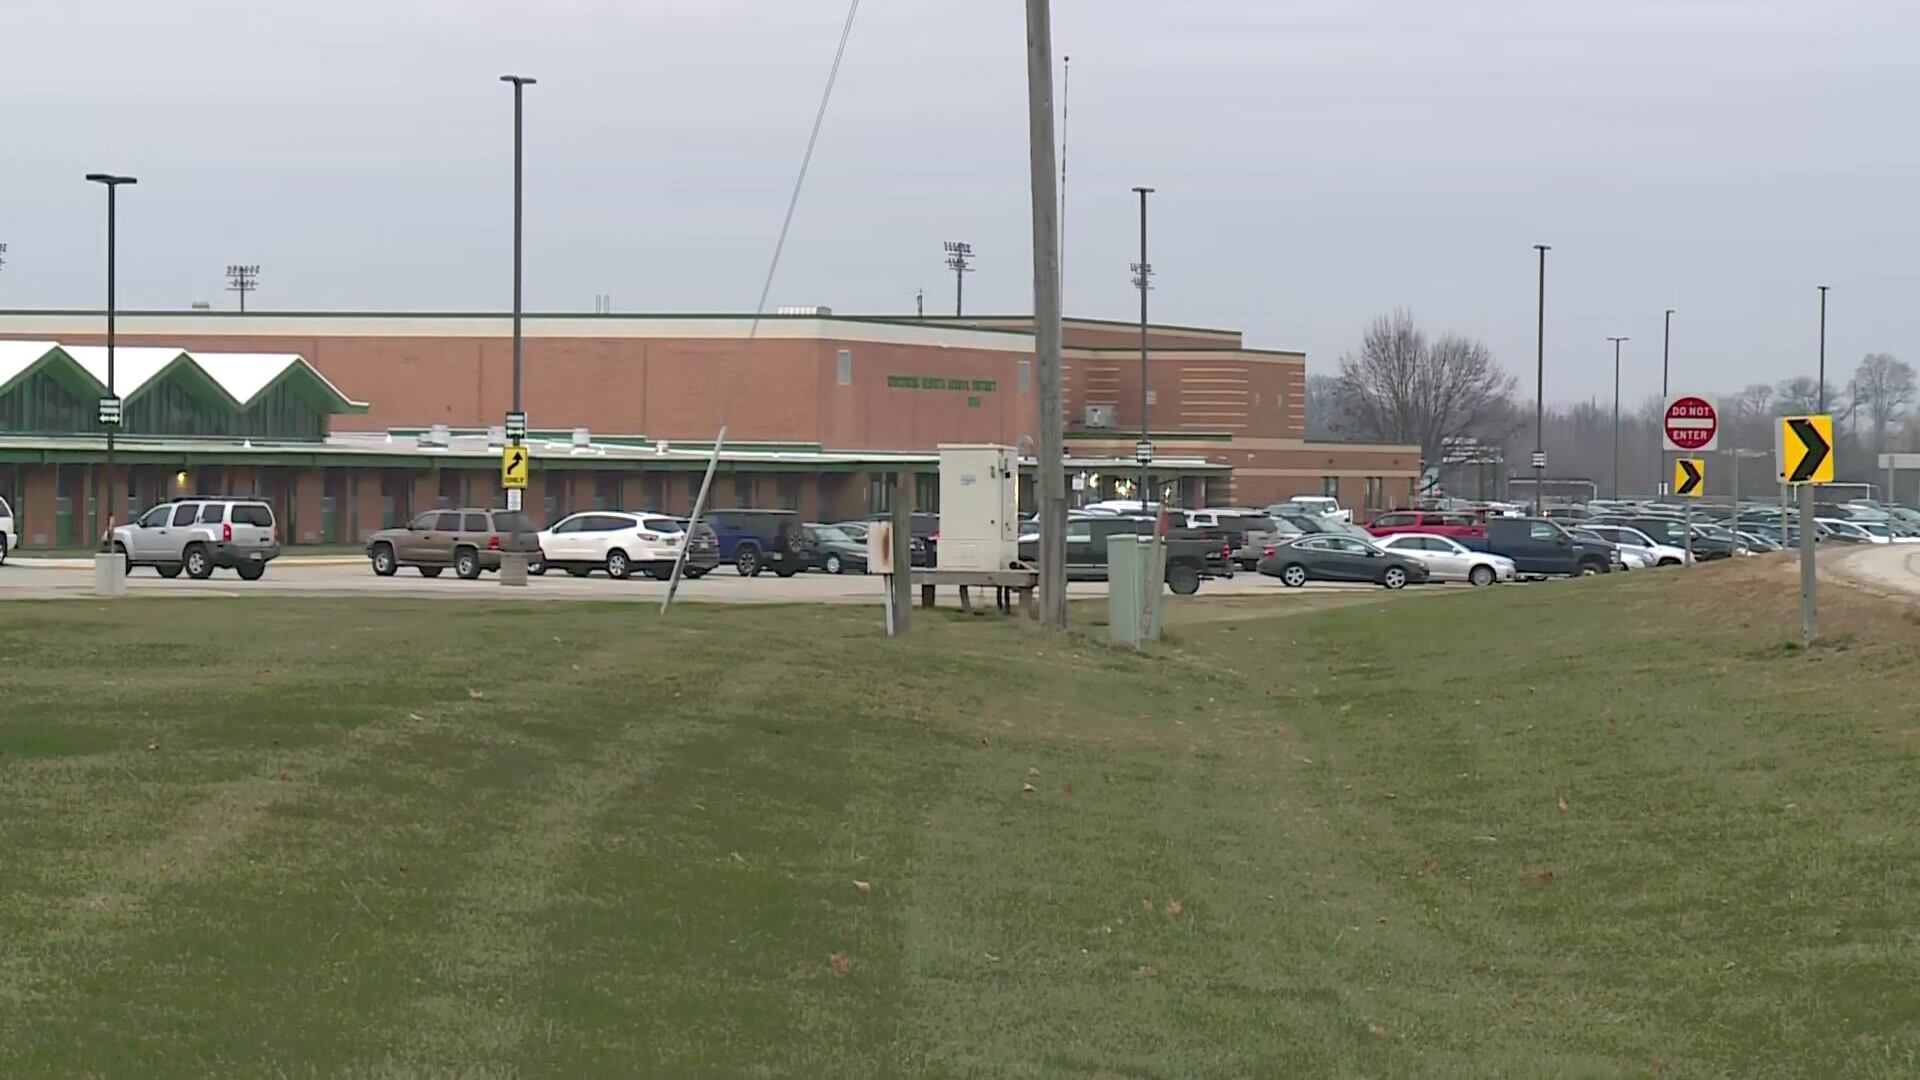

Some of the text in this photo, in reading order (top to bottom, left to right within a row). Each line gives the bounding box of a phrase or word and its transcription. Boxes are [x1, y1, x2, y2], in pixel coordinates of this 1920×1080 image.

[1672, 406, 1710, 416] DO NOT
[1673, 430, 1708, 440] ENTER
